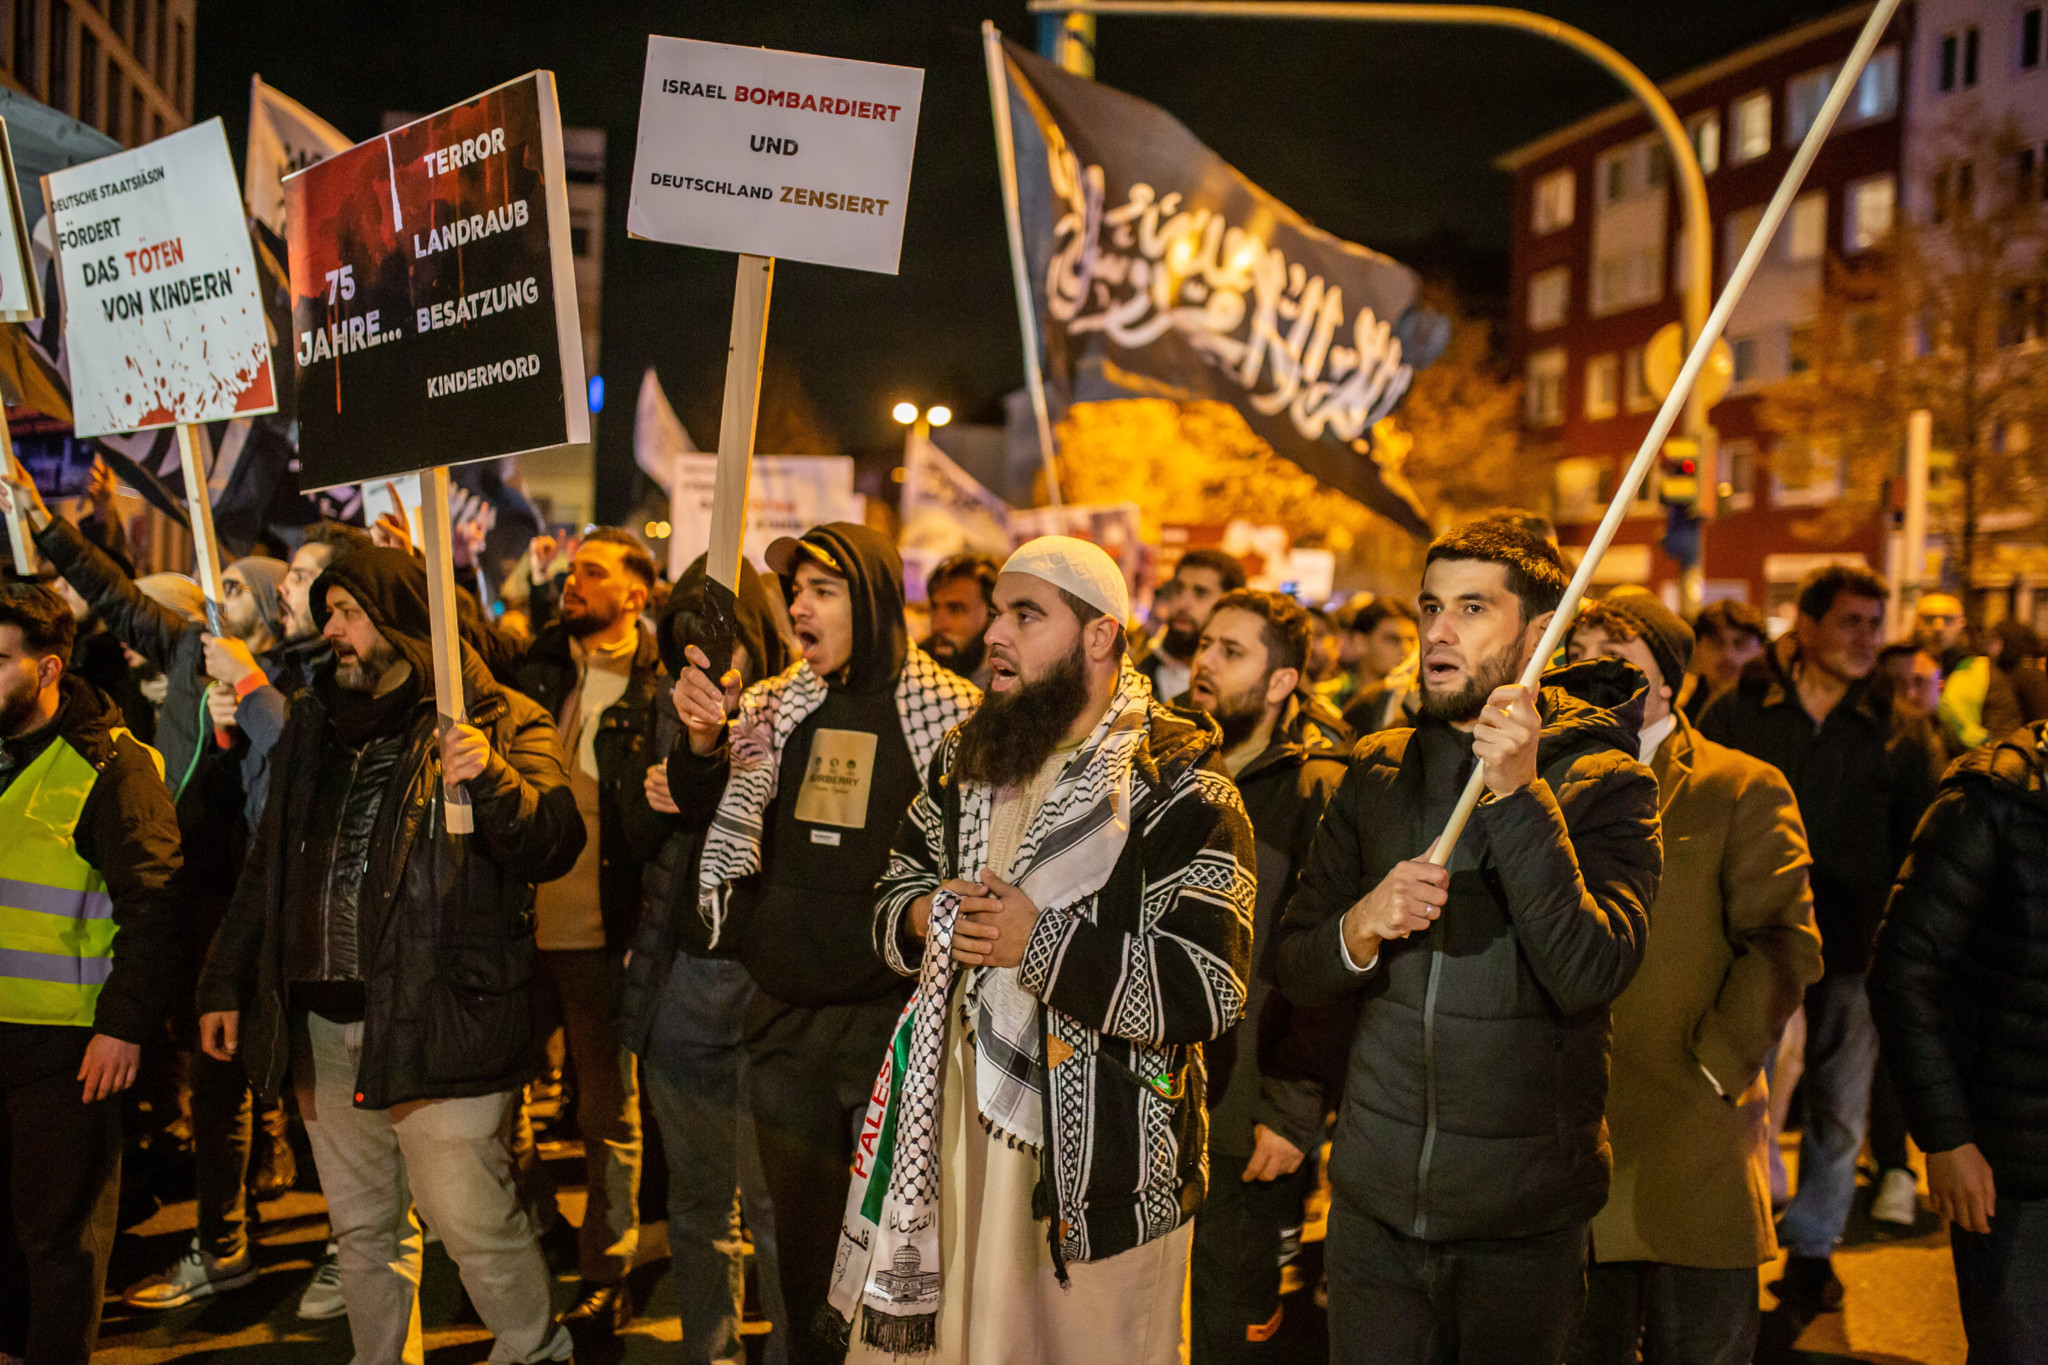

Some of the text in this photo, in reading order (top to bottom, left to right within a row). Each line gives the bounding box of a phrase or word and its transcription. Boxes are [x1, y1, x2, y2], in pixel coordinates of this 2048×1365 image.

[662, 78, 902, 122] ISRAEL BOMBARDIERT
[423, 127, 506, 178] TERROR
[750, 134, 799, 157] UND
[50, 187, 99, 214] DEUTSCHE
[650, 172, 889, 216] DEUTSCHLAND ZENSIERT
[57, 216, 121, 251] FÖRDERT
[413, 199, 529, 259] LANDRAUB
[82, 237, 184, 287] DAS TÖTEN
[102, 269, 233, 322] VON KINDERN
[325, 264, 355, 306] 75
[416, 276, 539, 334] BESATZUNG
[297, 309, 402, 367] JAHRE...
[427, 354, 541, 399] KINDERMORD
